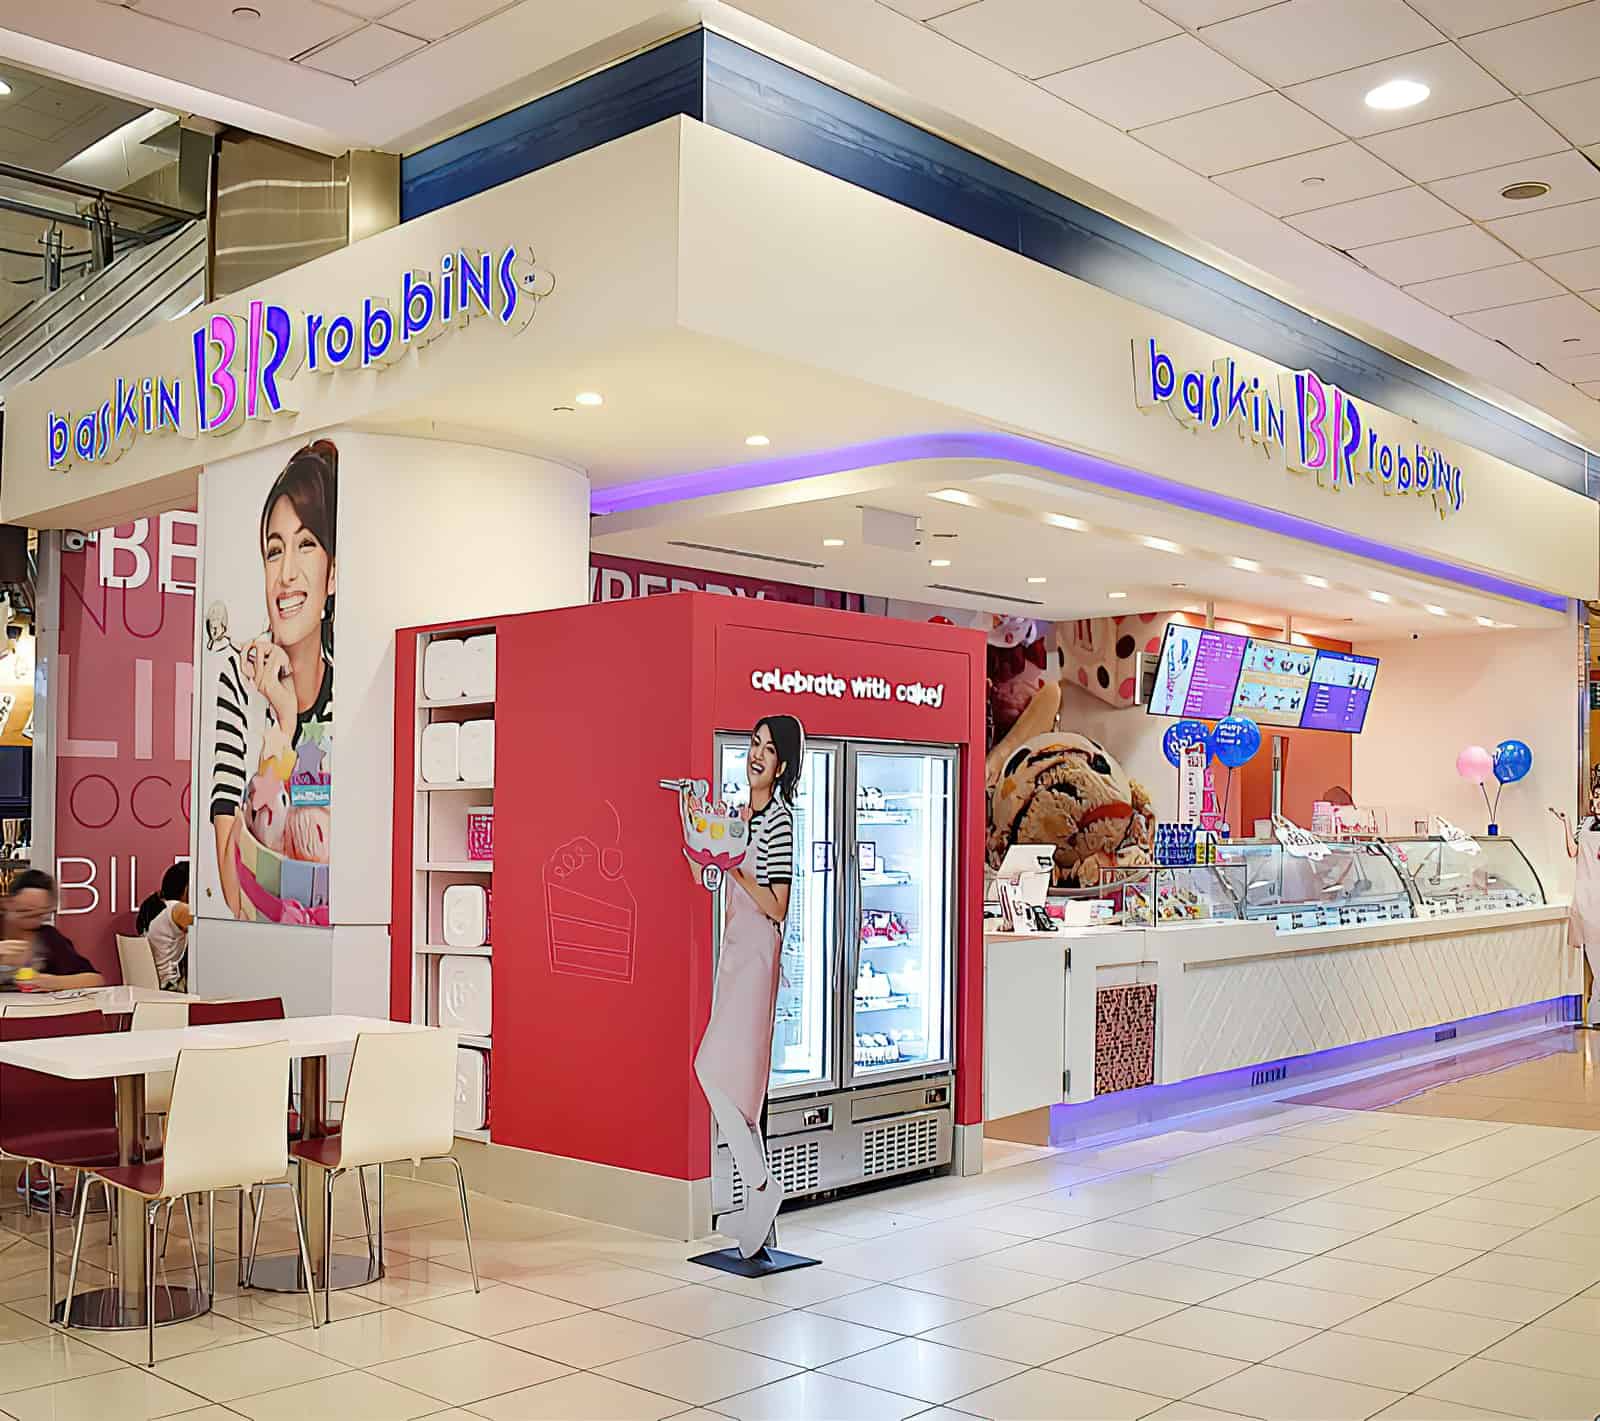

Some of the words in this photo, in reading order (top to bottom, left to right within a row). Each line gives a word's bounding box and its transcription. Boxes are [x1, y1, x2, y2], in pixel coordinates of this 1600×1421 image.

[192, 299, 292, 431] BR
[1294, 372, 1362, 487] BR
[751, 668, 847, 698] celebrate
[850, 677, 892, 700] with
